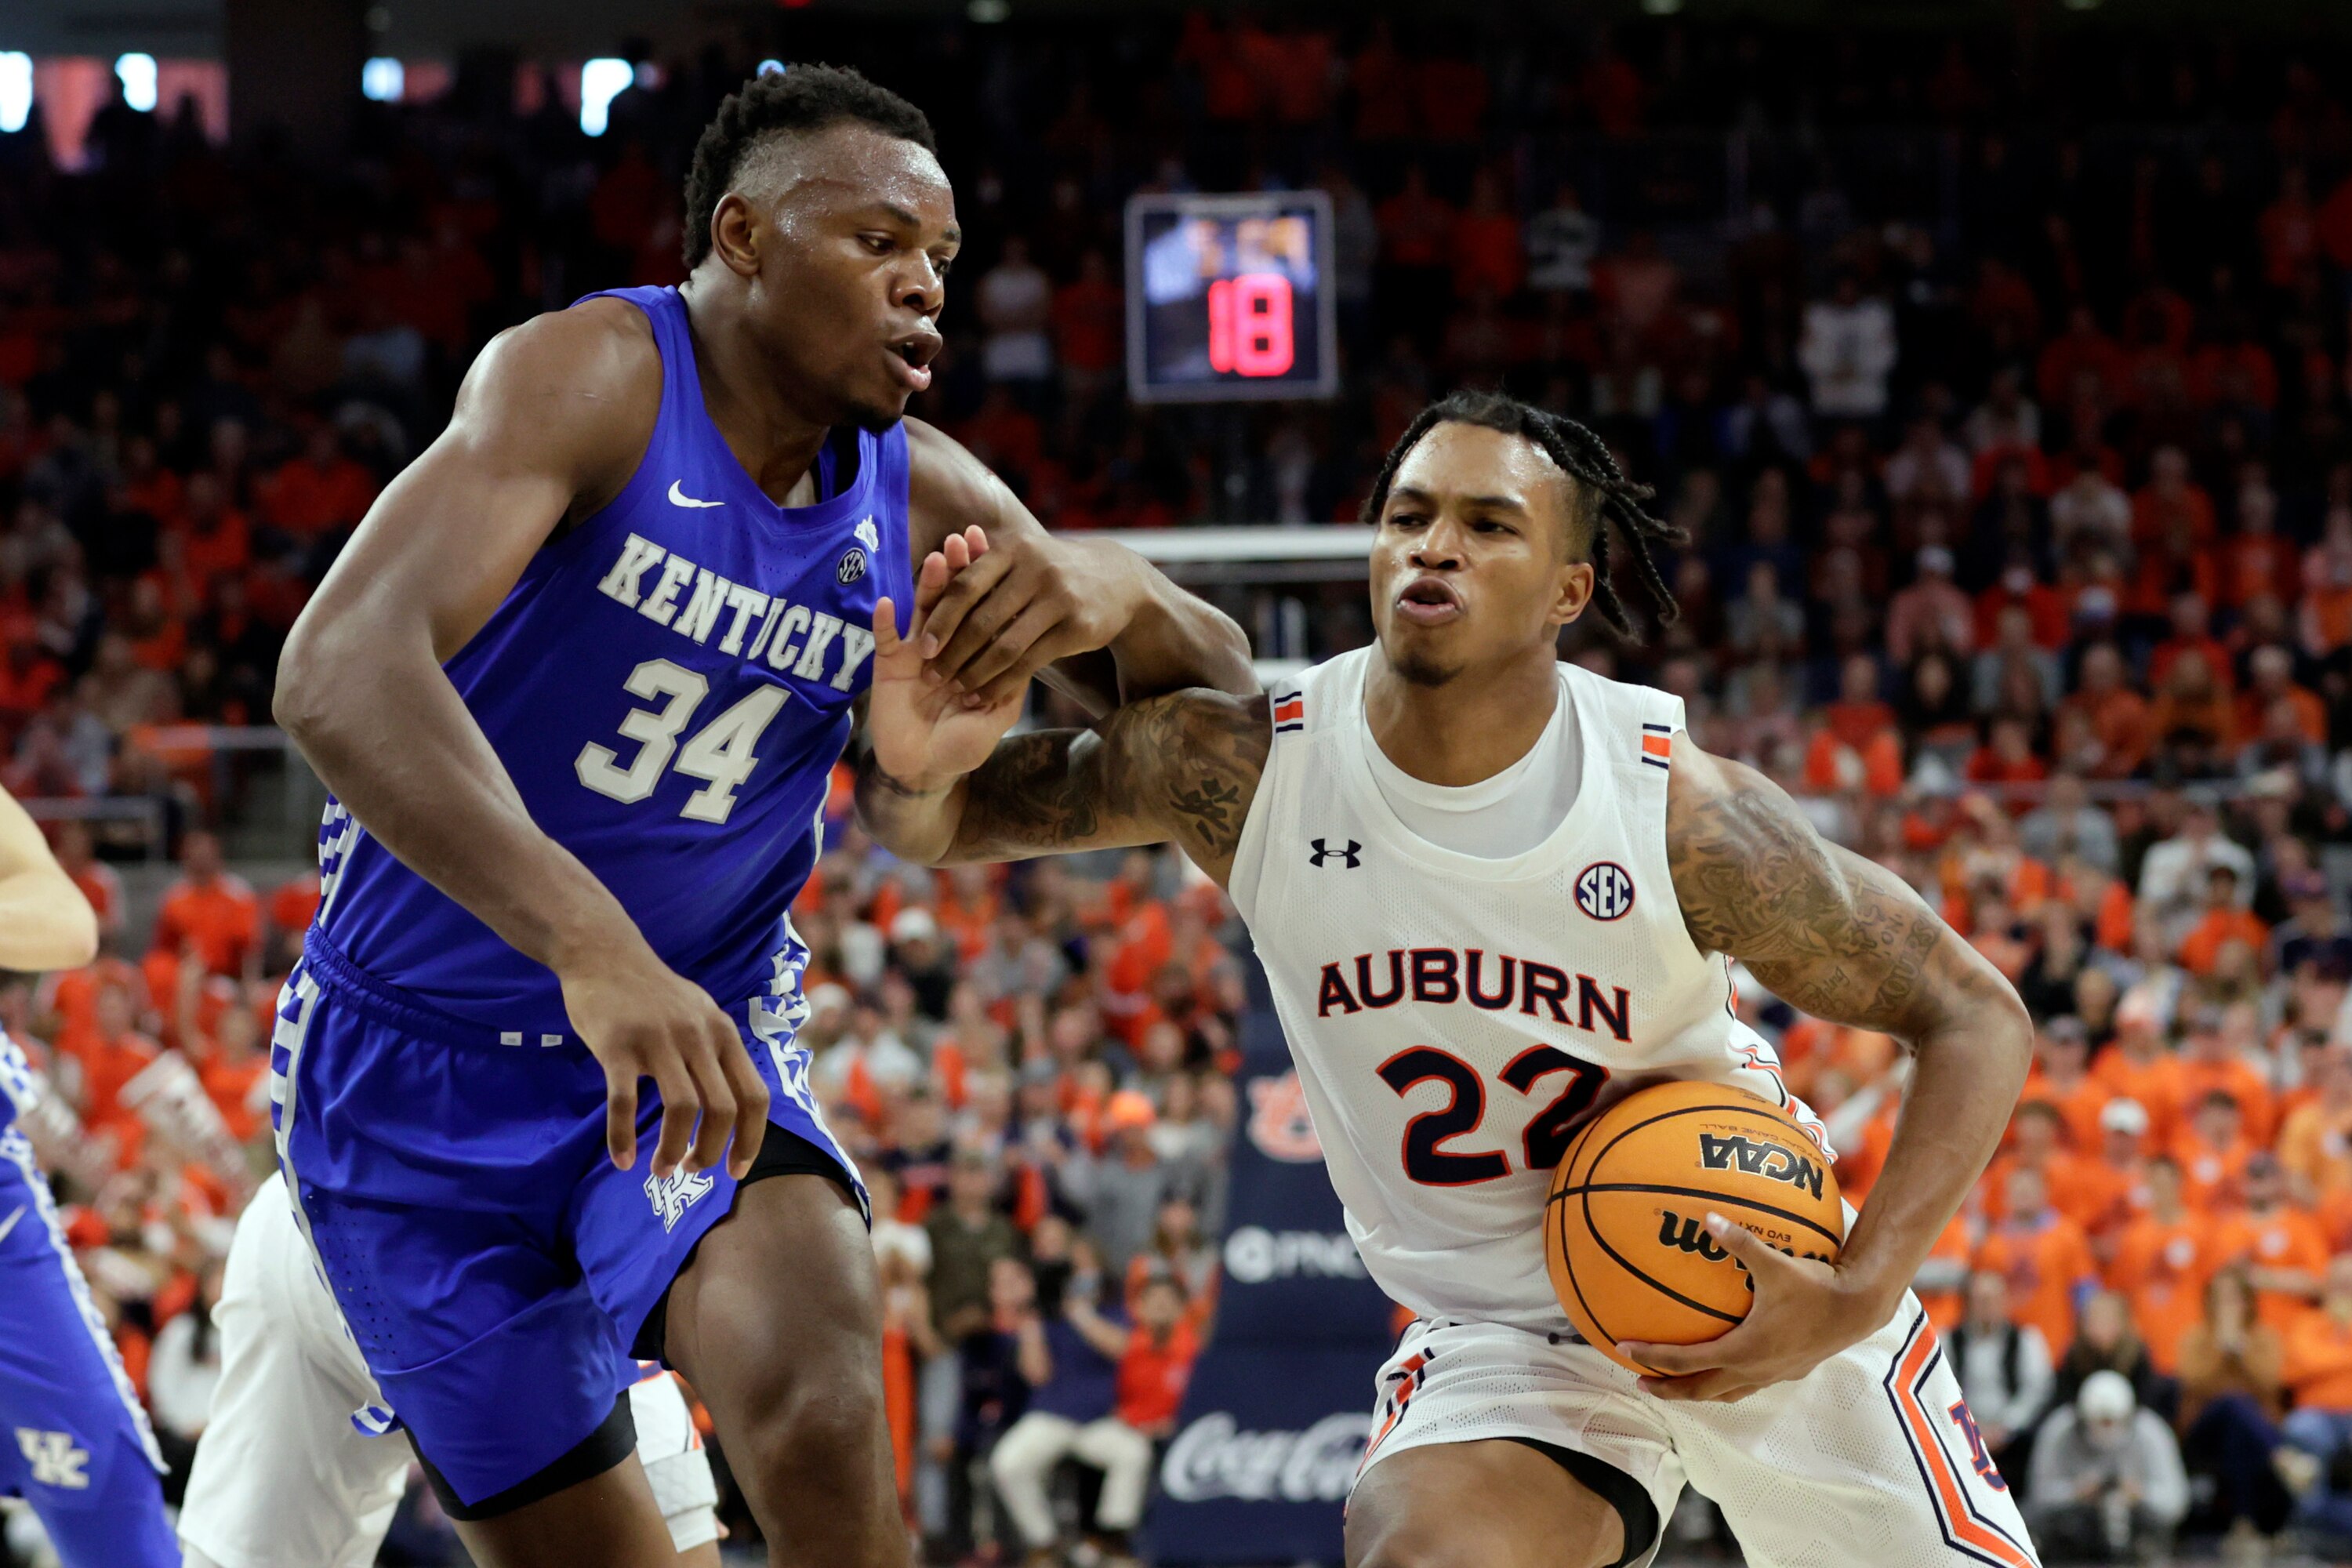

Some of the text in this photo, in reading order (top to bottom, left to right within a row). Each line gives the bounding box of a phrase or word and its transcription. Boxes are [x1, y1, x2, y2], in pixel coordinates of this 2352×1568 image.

[1208, 273, 1294, 377] 18
[597, 532, 876, 693] KENTUCKY
[839, 550, 865, 583] SEC
[574, 657, 791, 825] 34
[1577, 865, 1630, 918] SEC
[1318, 947, 1632, 1044] AUBURN
[1376, 1044, 1611, 1186] 22
[1699, 1133, 1824, 1201] NCAA
[14, 1427, 89, 1489] UK
